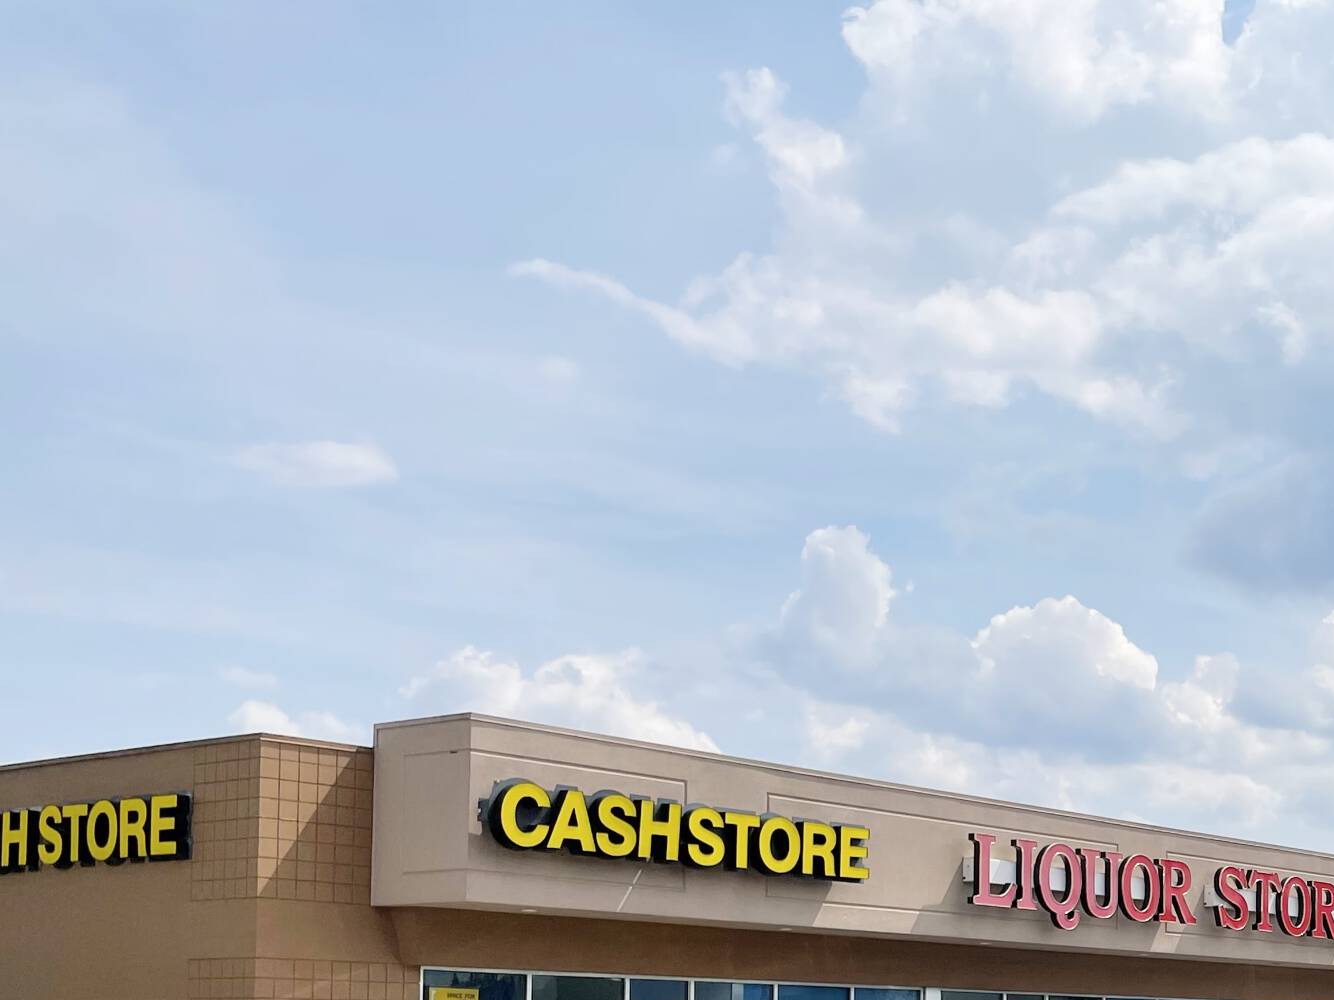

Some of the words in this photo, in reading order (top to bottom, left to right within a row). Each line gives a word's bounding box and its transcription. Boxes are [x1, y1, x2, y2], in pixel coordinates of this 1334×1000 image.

[38, 794, 178, 865] STORE
[500, 783, 682, 861] CASH
[687, 807, 871, 880] STORE
[970, 833, 1197, 930] LIQUOR
